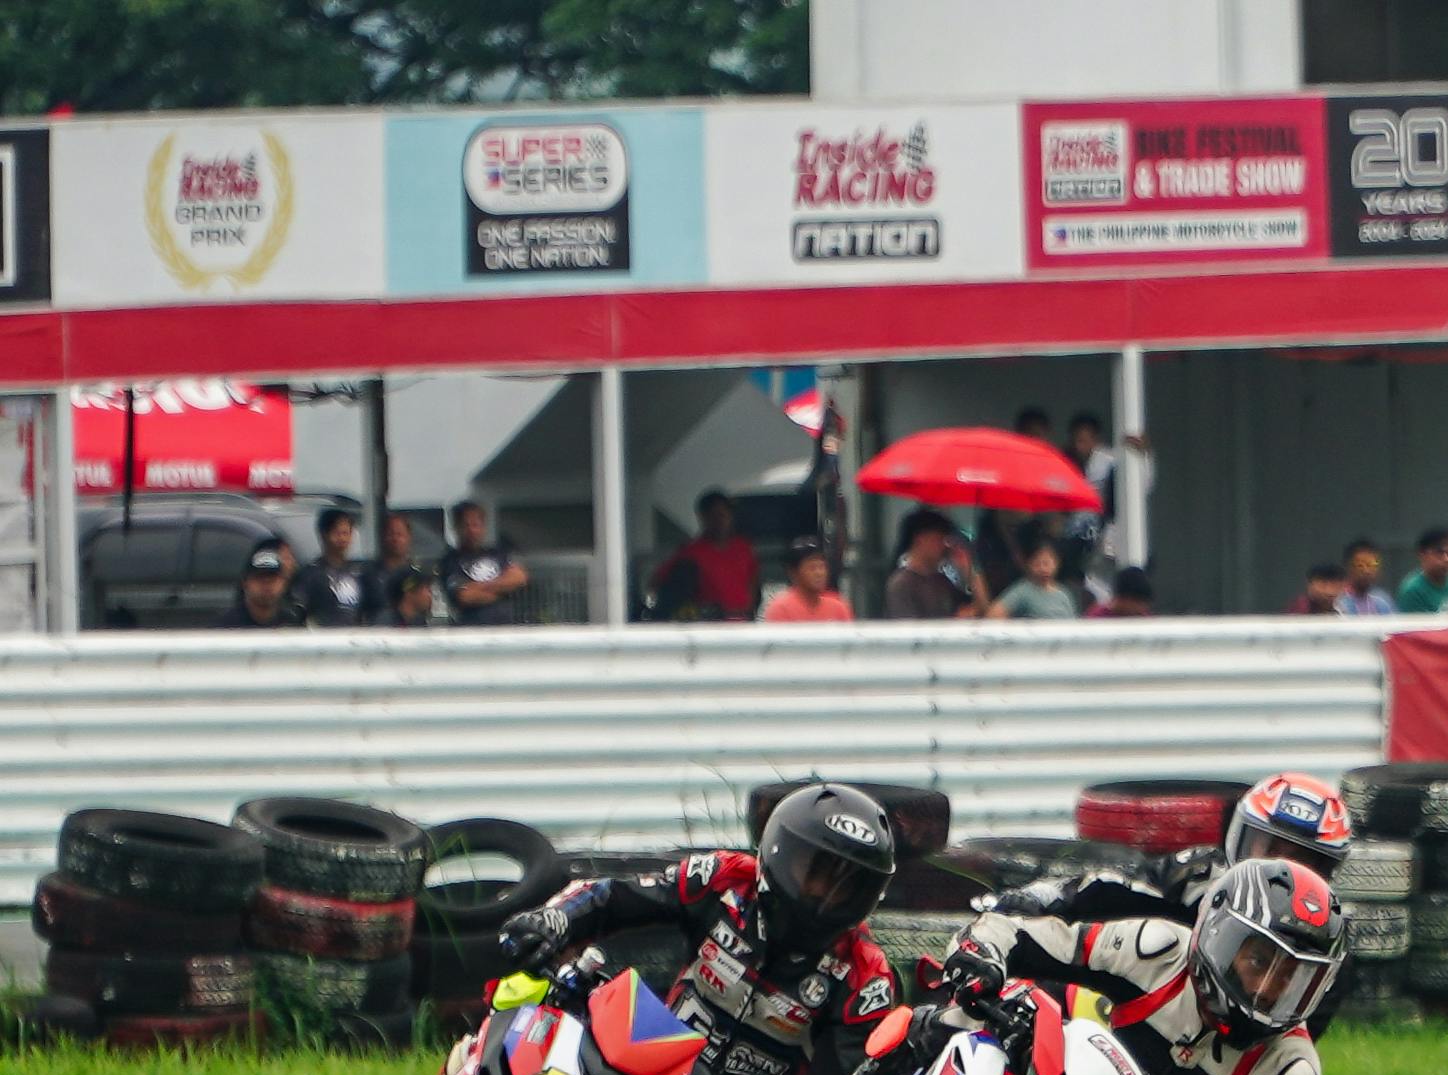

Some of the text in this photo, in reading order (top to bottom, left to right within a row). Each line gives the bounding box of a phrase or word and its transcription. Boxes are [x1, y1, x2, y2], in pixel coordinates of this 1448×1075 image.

[482, 137, 582, 166] SUPER
[797, 125, 899, 171] Inside
[1197, 126, 1300, 157] FESTIVAL
[502, 165, 609, 195] SERIES
[796, 168, 935, 206] RACING
[1133, 154, 1304, 198] & TRADE SHOW
[175, 203, 262, 224] GRAND
[1361, 189, 1448, 215] YEARS
[190, 227, 246, 247] PRIX
[477, 220, 523, 248] ONE
[484, 246, 530, 270] ONE
[145, 461, 217, 488] MOTUL
